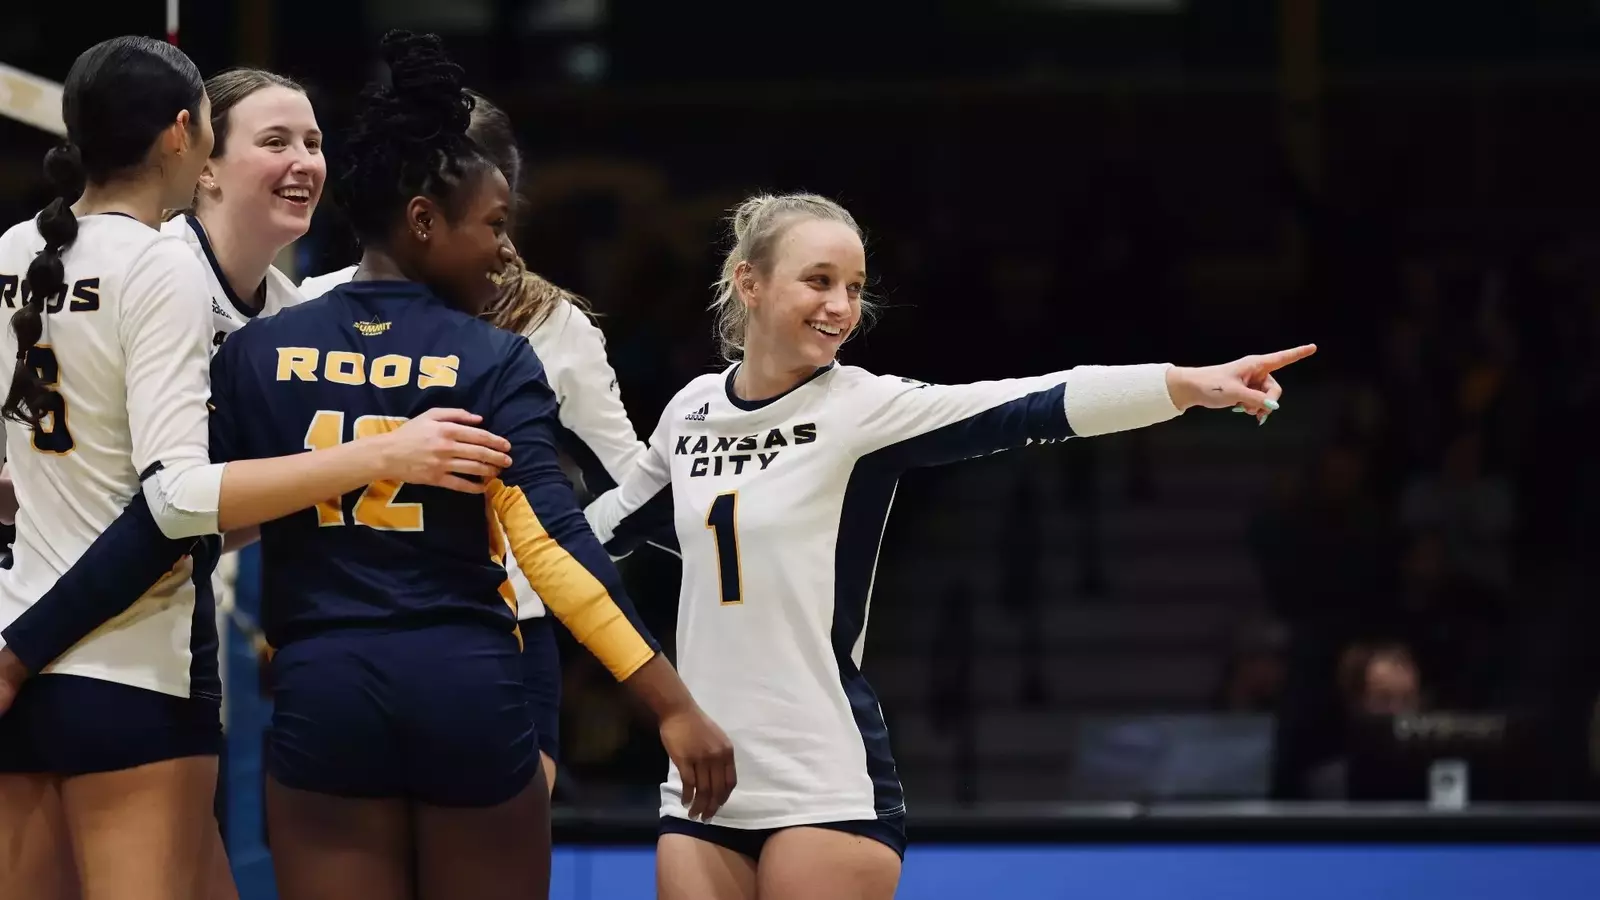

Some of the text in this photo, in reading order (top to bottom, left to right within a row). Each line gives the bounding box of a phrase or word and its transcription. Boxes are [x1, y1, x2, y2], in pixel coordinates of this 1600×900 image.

[352, 321, 392, 332] SUMMIT
[276, 347, 460, 389] ROOS
[675, 422, 817, 455] KANSAS
[303, 410, 424, 531] 12
[690, 451, 780, 477] CITY
[705, 489, 744, 606] 1
